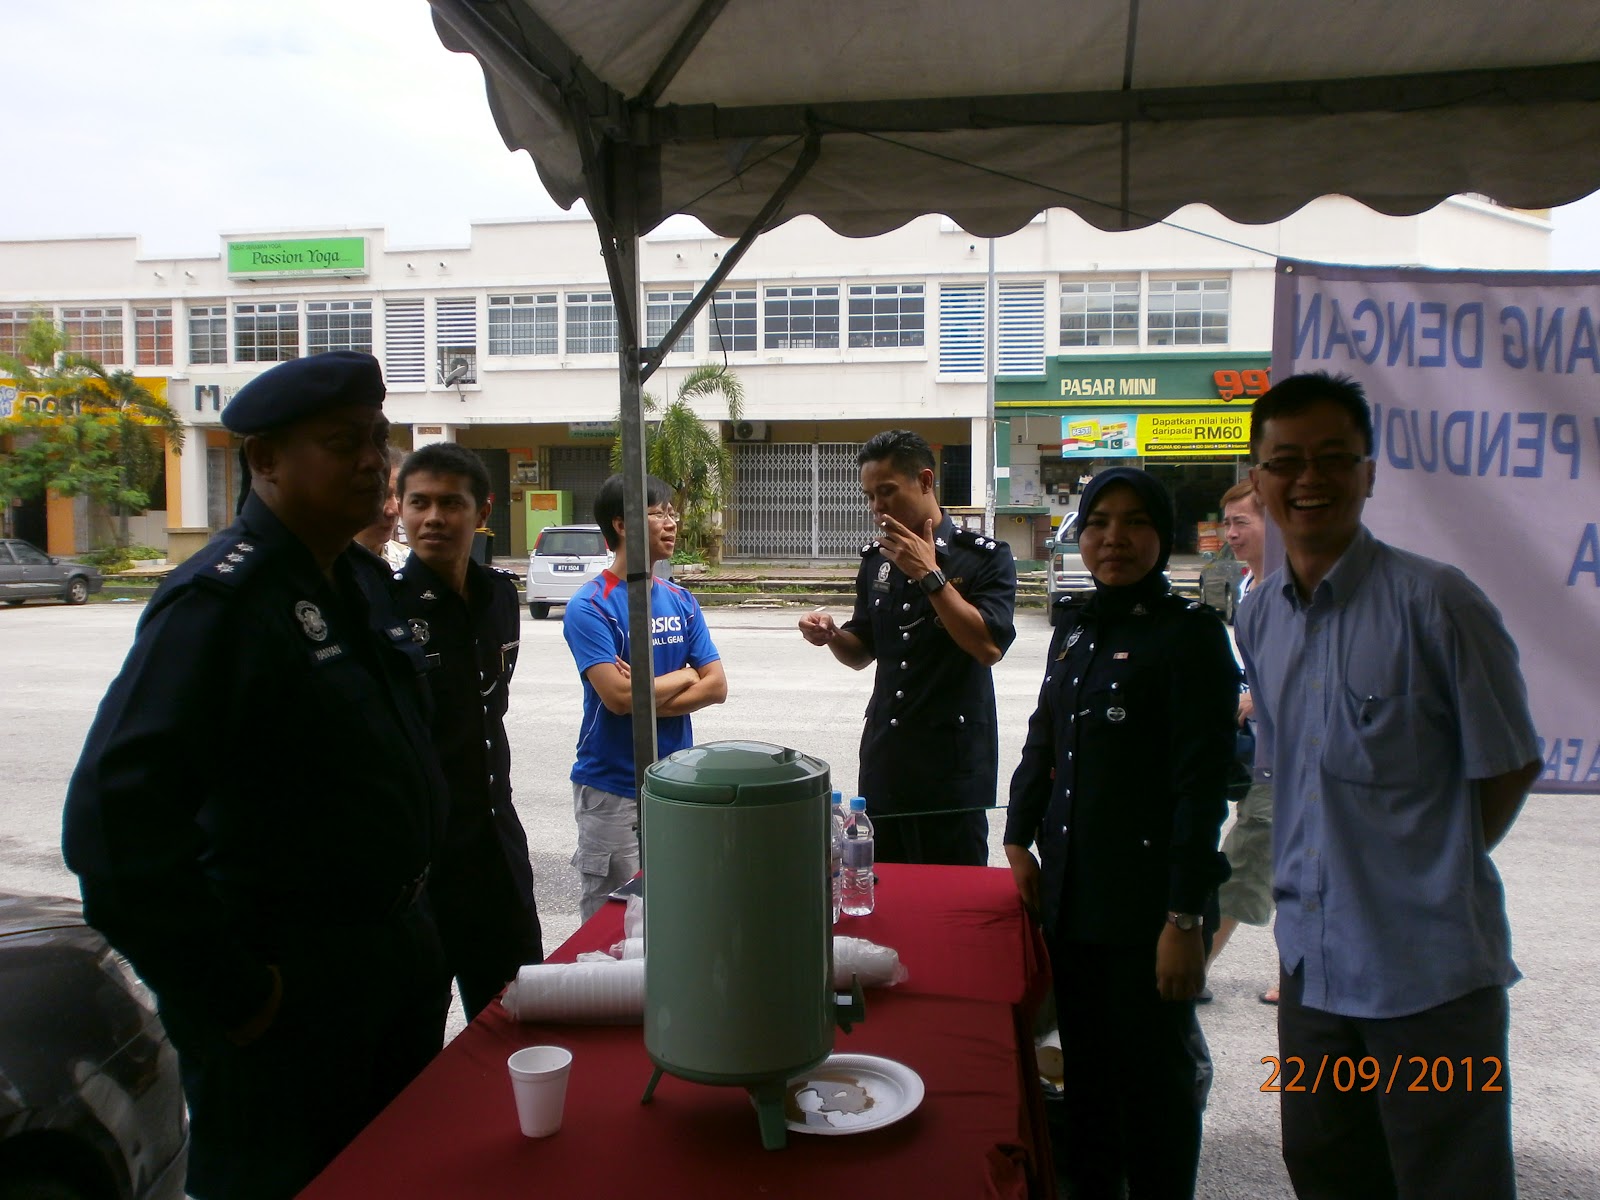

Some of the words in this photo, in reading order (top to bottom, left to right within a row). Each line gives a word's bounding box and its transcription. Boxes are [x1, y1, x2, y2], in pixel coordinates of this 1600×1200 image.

[252, 250, 303, 265] Passion
[308, 249, 340, 268] Yoga
[1060, 378, 1115, 396] PASAR
[1119, 378, 1156, 396] MINI
[1152, 417, 1197, 426] Dapatkan
[1199, 416, 1218, 425] nilai
[1220, 416, 1243, 425] lebih
[1152, 427, 1193, 436] daripada
[1194, 426, 1243, 440] RM60
[652, 637, 667, 646] ALL
[667, 635, 684, 644] GEAR
